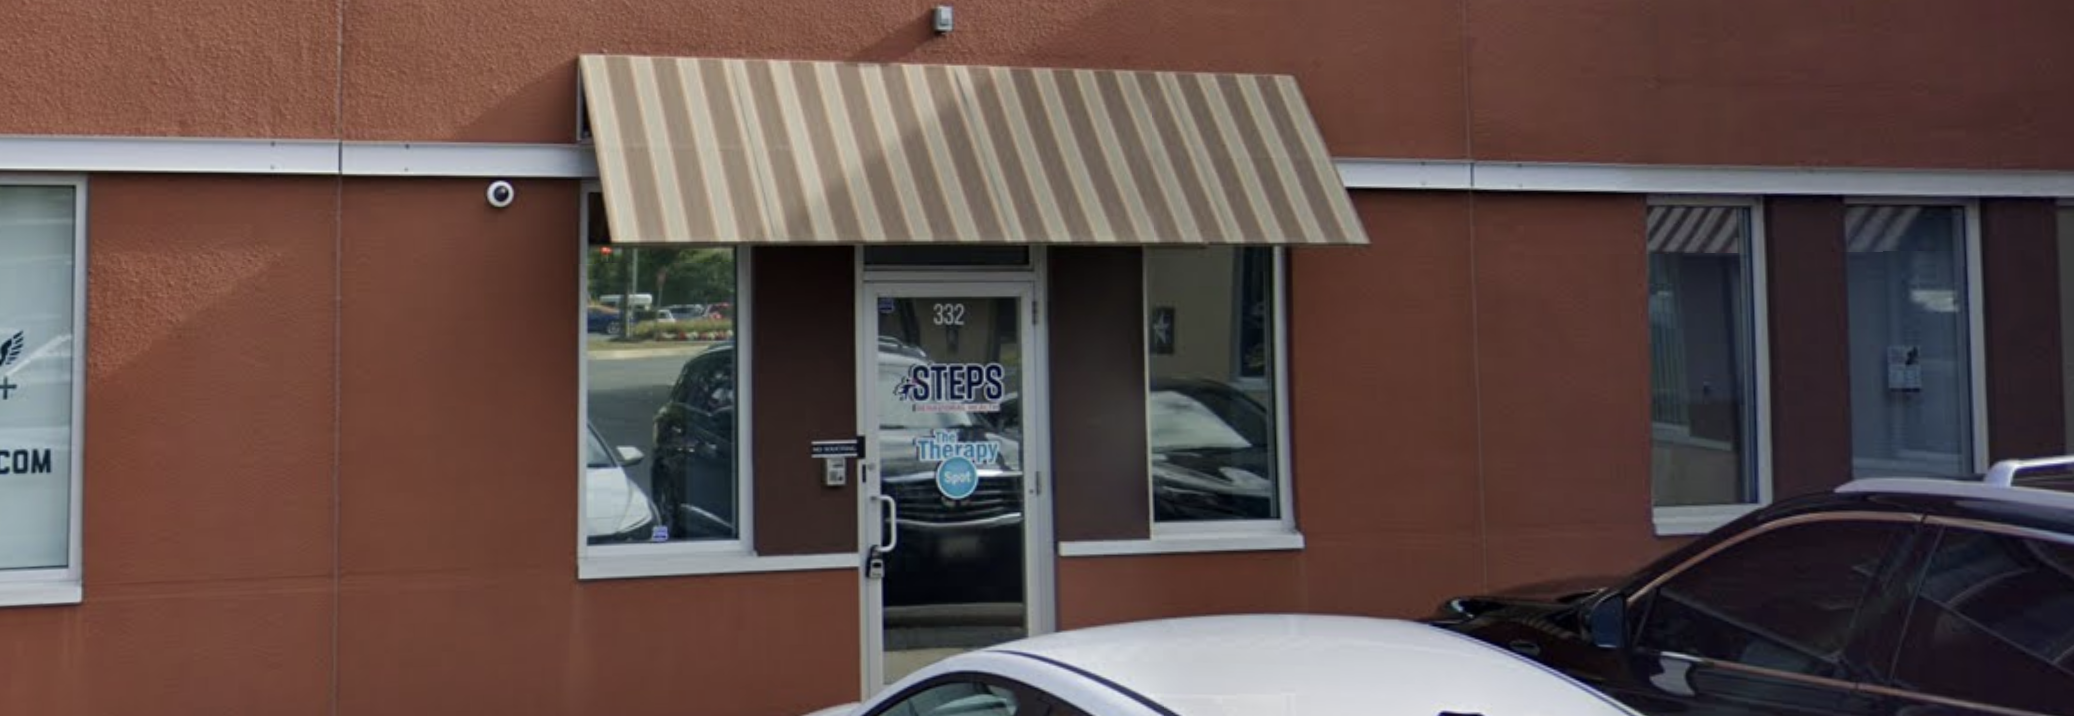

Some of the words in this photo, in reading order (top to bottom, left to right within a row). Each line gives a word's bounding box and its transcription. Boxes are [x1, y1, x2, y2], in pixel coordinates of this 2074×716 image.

[933, 303, 965, 326] 332
[912, 364, 1003, 402] STEPS
[935, 431, 956, 443] The
[918, 440, 999, 463] Therapy
[944, 471, 972, 486] Spot
